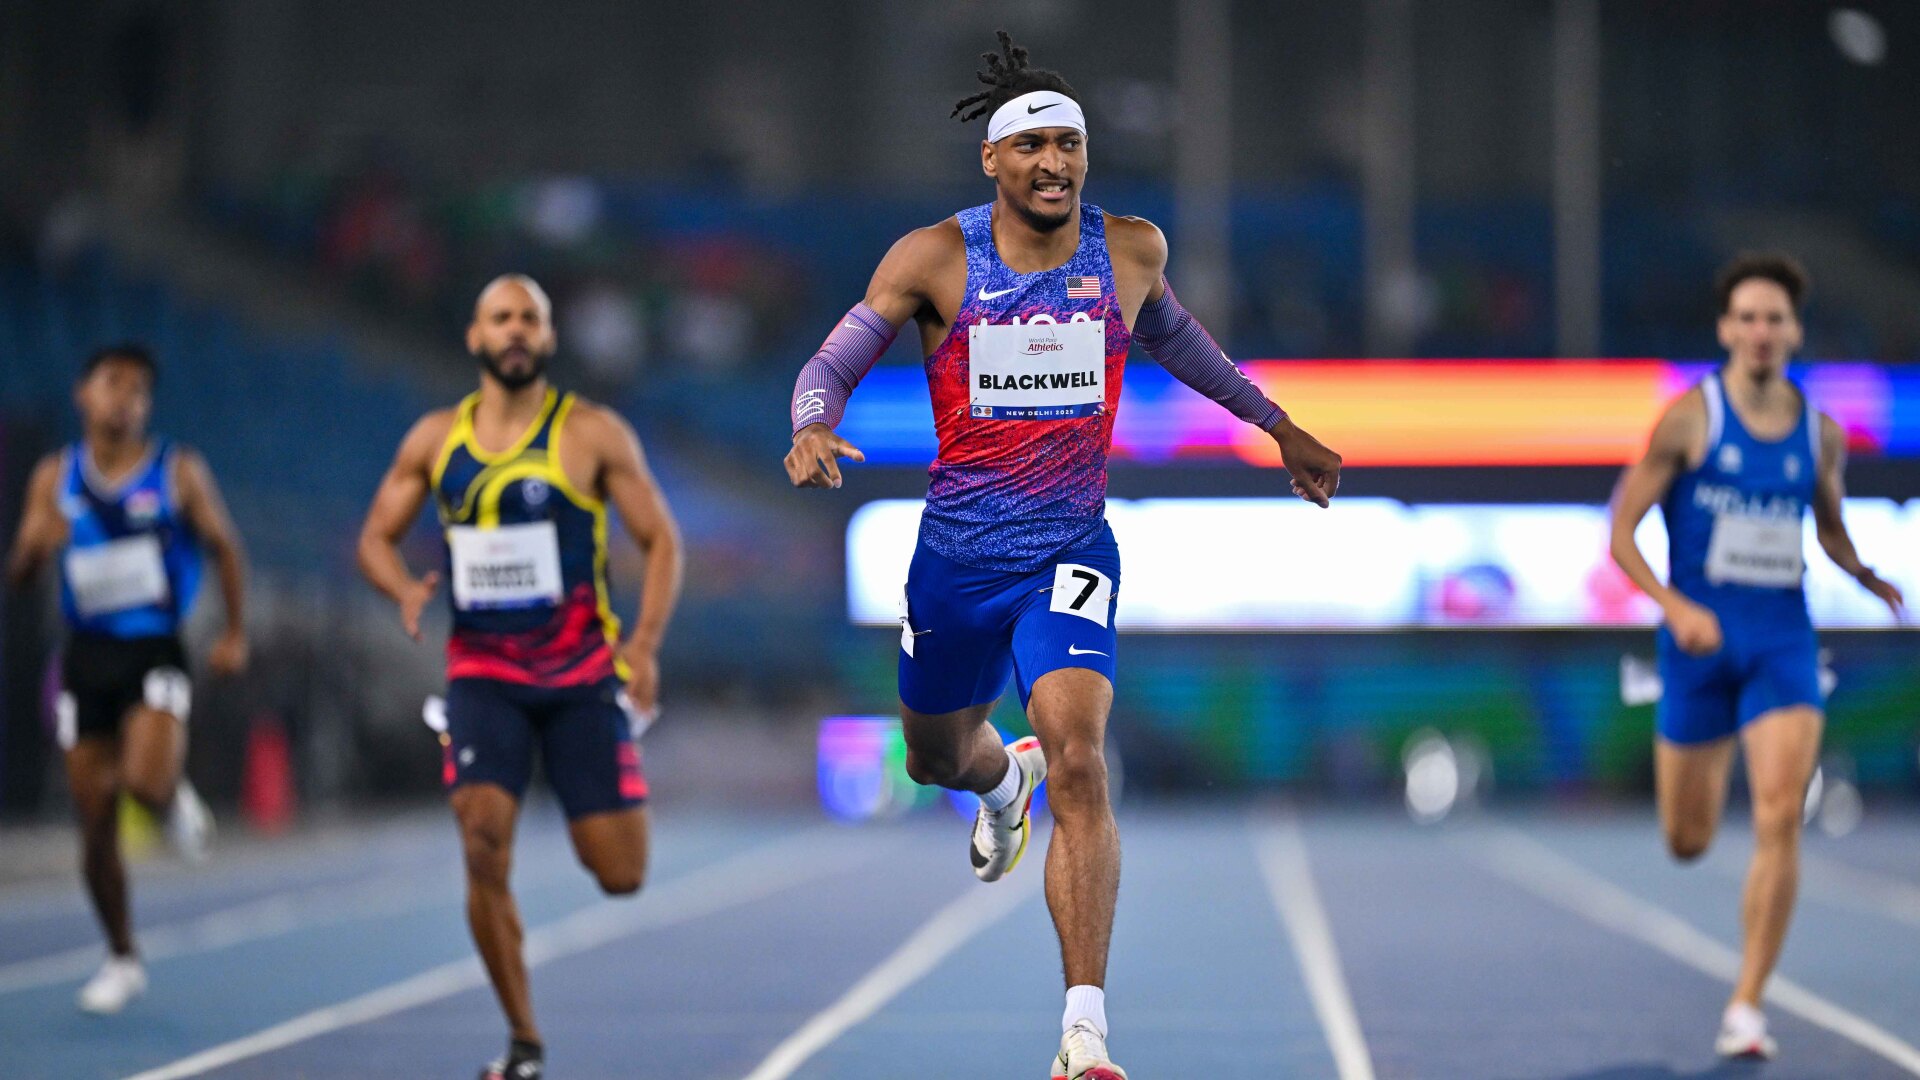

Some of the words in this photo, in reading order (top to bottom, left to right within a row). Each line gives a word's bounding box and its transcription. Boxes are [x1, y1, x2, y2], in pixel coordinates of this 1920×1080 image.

[1027, 342, 1064, 352] Athletics
[978, 370, 1098, 390] BLACKWELL
[1068, 569, 1100, 611] 7
